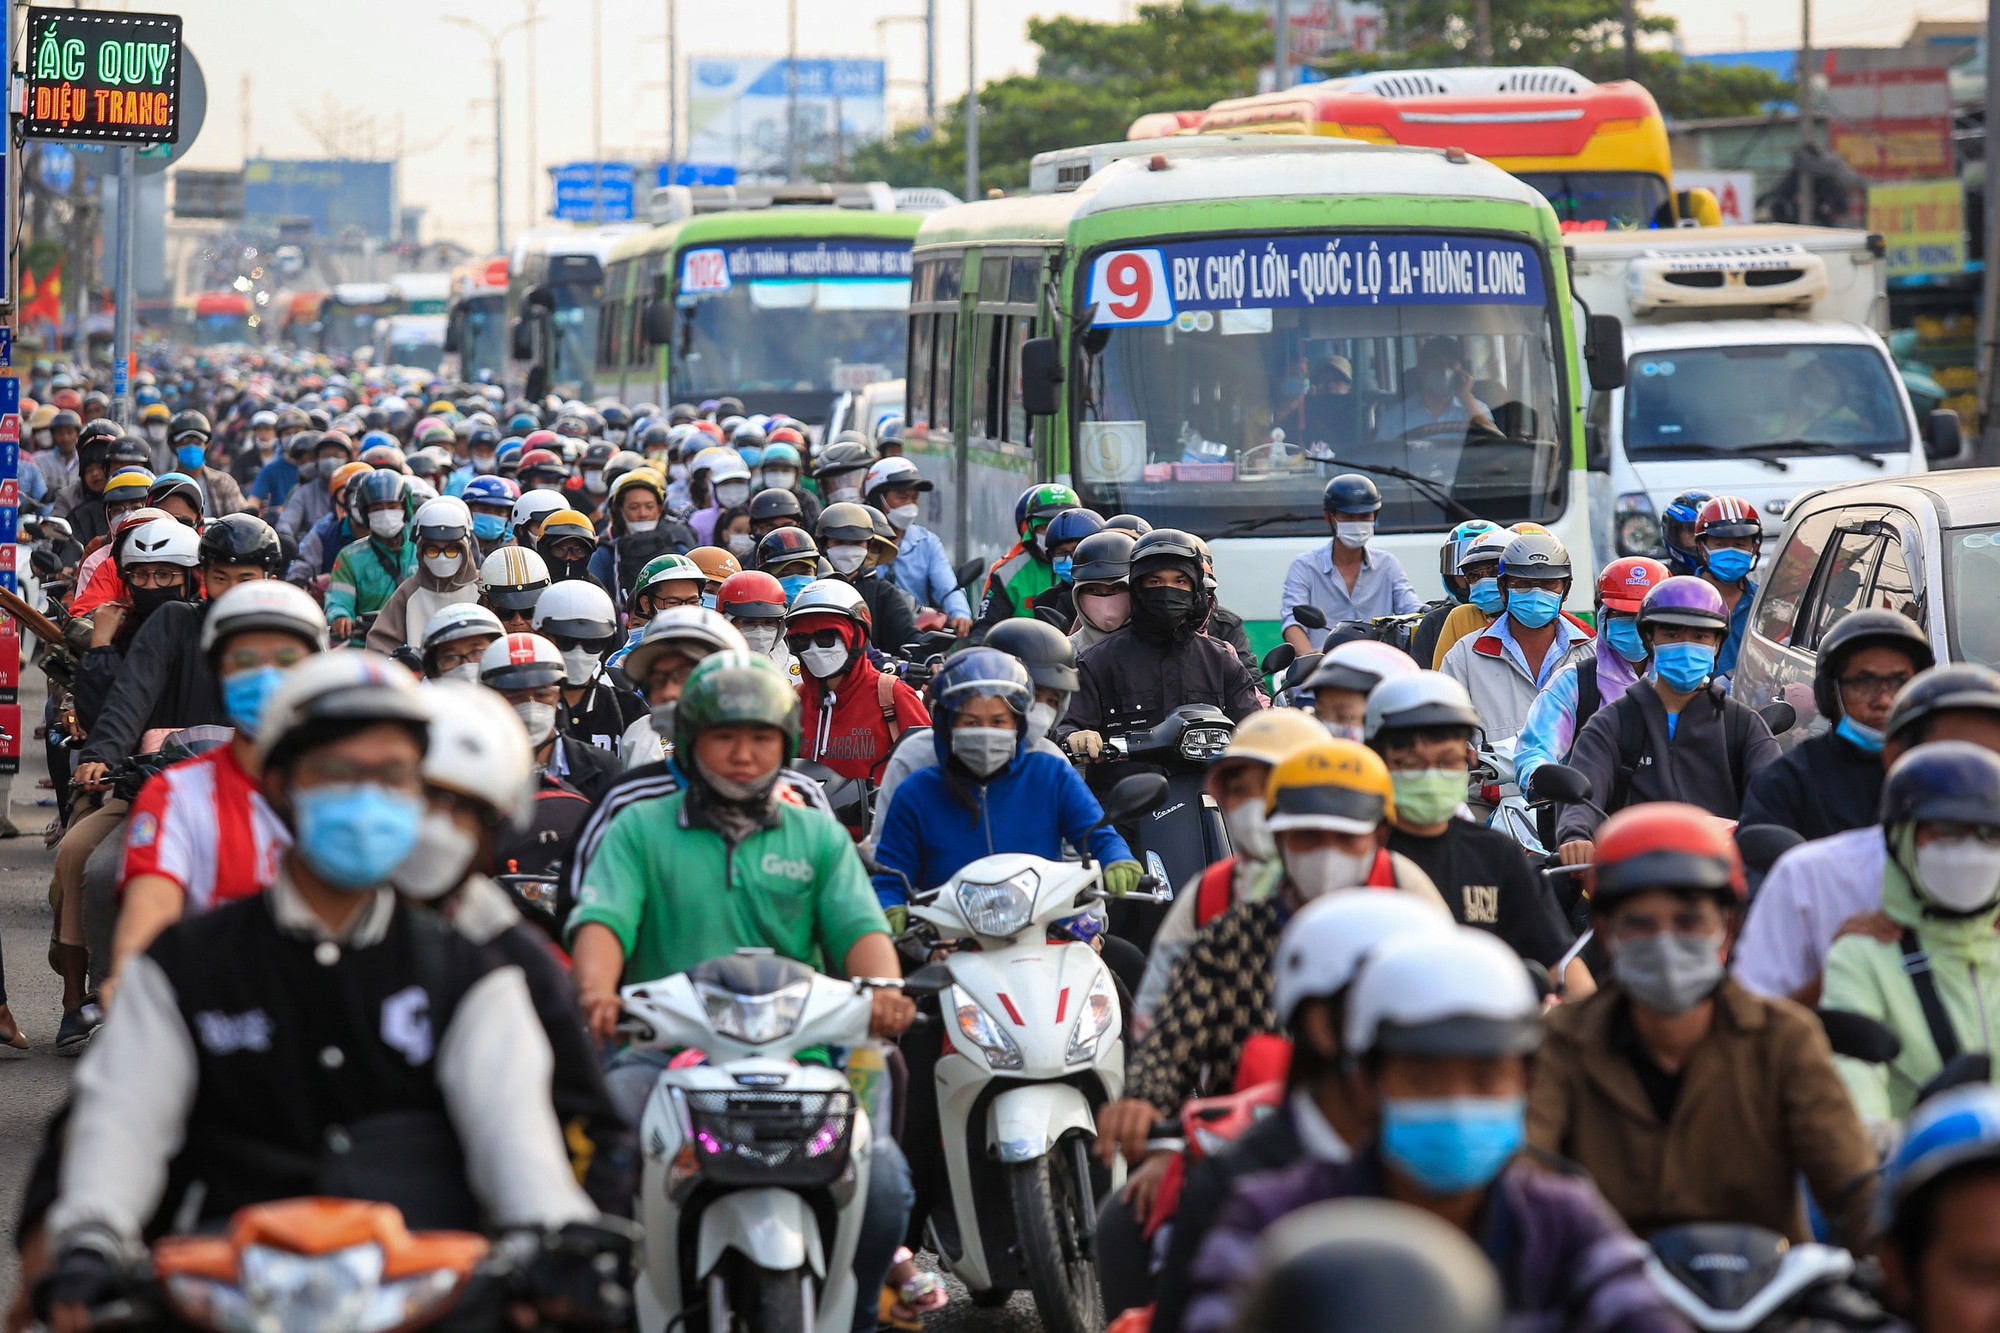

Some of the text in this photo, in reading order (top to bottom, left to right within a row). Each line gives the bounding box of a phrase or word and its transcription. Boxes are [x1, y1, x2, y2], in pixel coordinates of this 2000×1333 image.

[37, 21, 170, 86] ẮC QUY
[36, 81, 169, 127] DIỆU TRANG
[689, 252, 726, 288] 102
[1106, 253, 1153, 319] 9
[1173, 257, 1201, 301] BX
[1205, 249, 1246, 308] CHỢ
[1356, 240, 1382, 304] LỘ
[1477, 250, 1526, 295] LONG
[851, 727, 872, 736] D&G
[1152, 802, 1186, 820] Vespa
[761, 853, 815, 882] Grab
[1462, 885, 1498, 907] UNI
